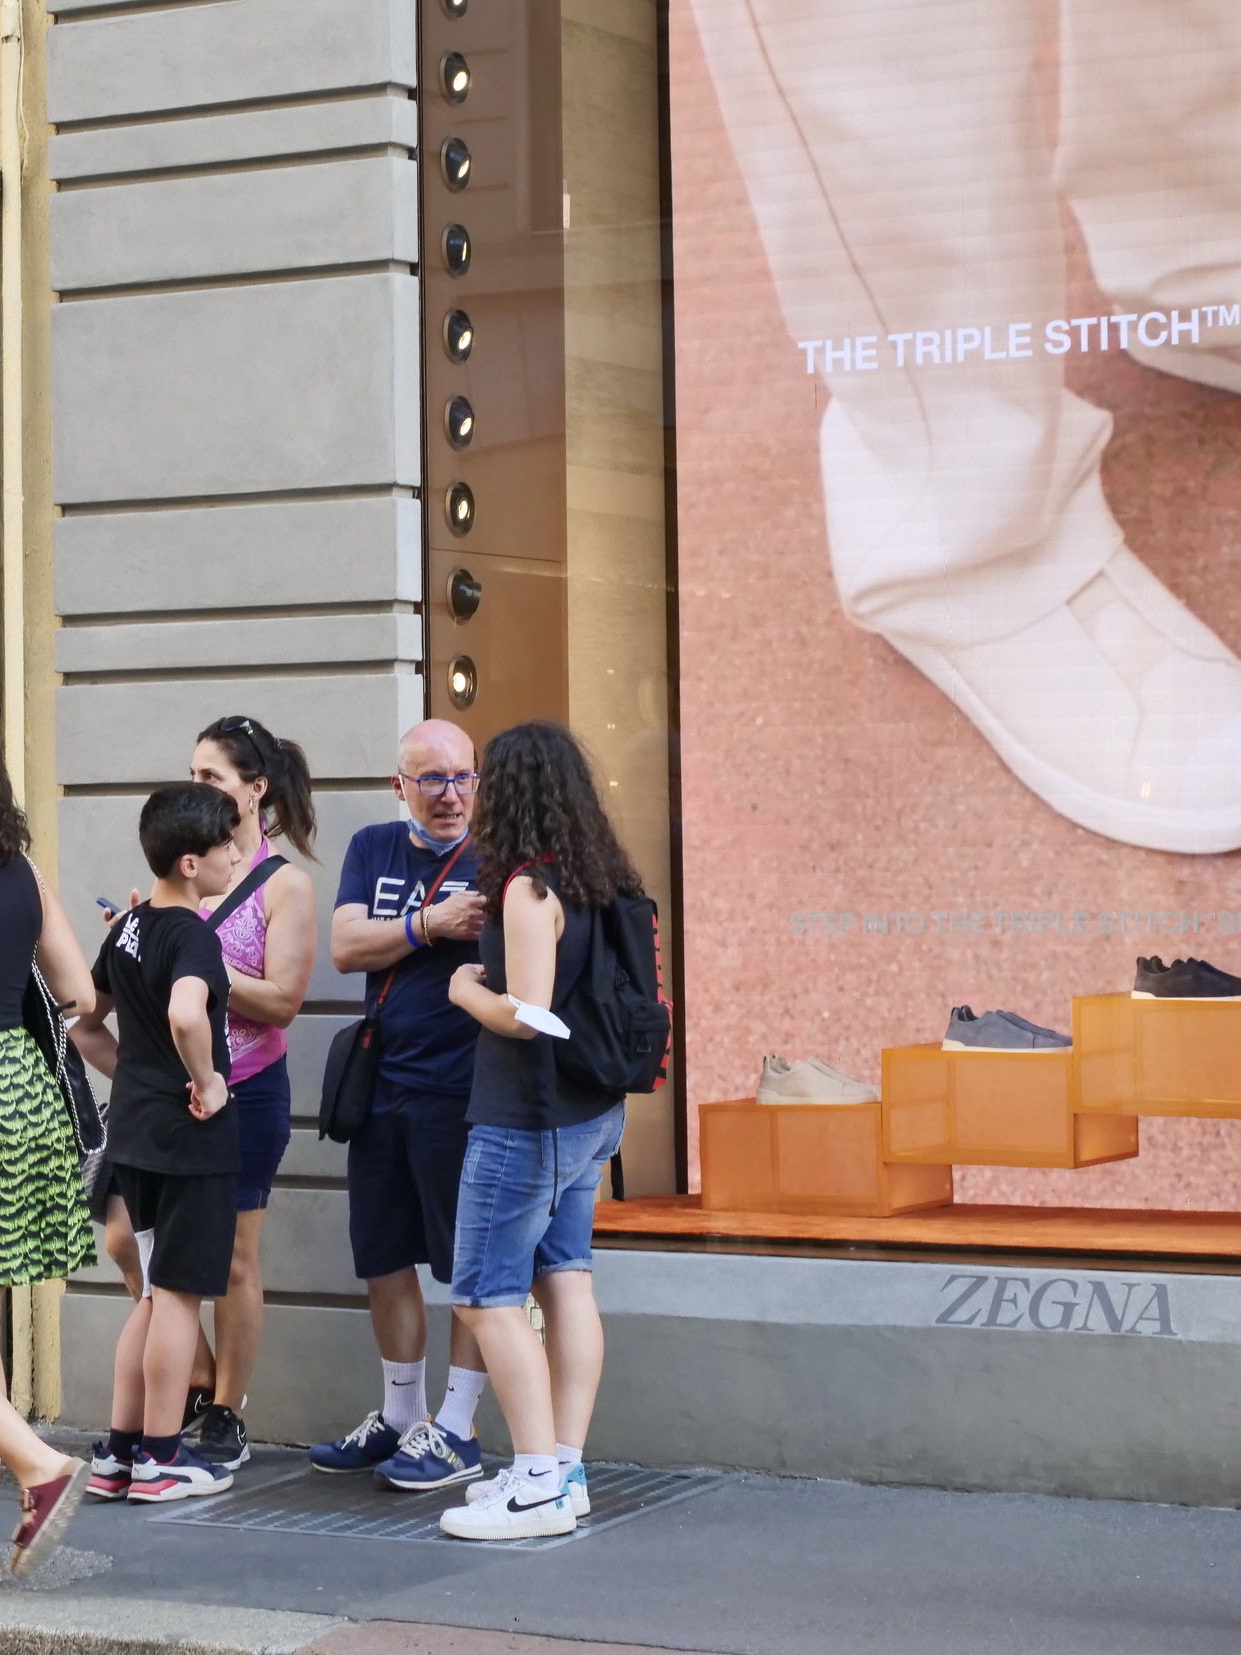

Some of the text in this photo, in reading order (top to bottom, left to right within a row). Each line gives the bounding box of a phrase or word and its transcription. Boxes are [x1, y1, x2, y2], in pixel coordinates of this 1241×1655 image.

[797, 335, 878, 374] THE
[888, 322, 1032, 367] TRIPLE
[789, 911, 857, 935] STEP
[862, 911, 926, 935] INTO
[931, 911, 987, 935] THE
[992, 910, 1091, 935] TRIPLE
[934, 1273, 1179, 1337] ZEGNA
